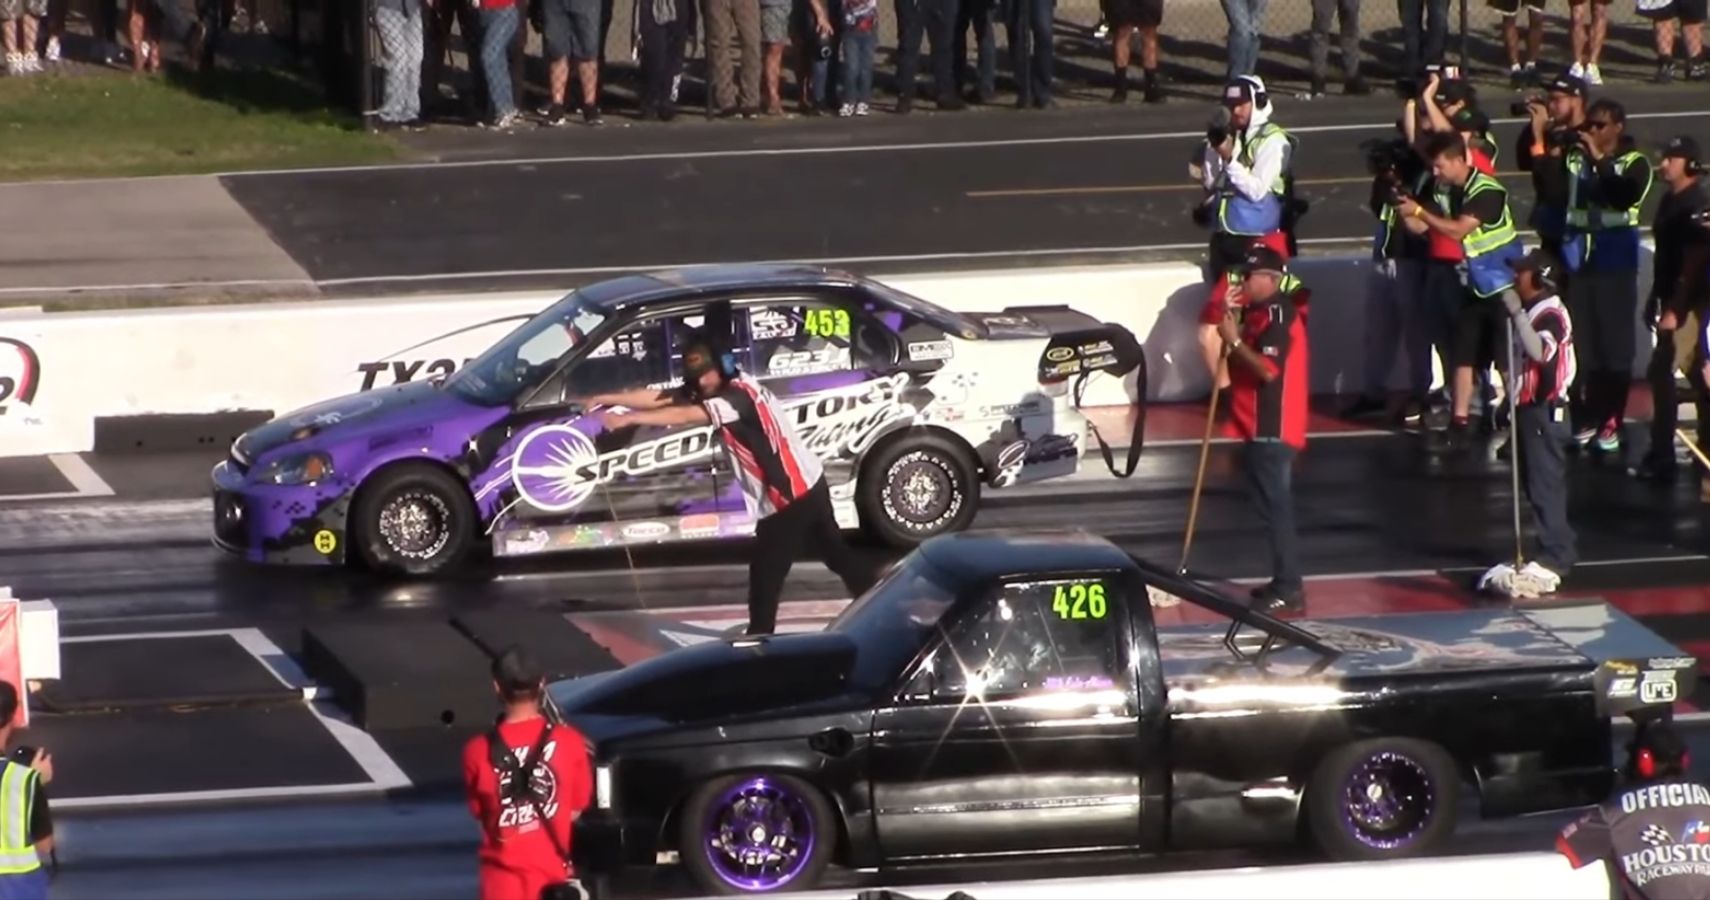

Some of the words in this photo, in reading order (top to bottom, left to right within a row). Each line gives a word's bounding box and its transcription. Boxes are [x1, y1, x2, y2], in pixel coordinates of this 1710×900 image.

[804, 309, 850, 337] 453
[357, 358, 477, 394] TX2
[1053, 584, 1107, 619] 426
[1622, 843, 1710, 873] HOUSTO
